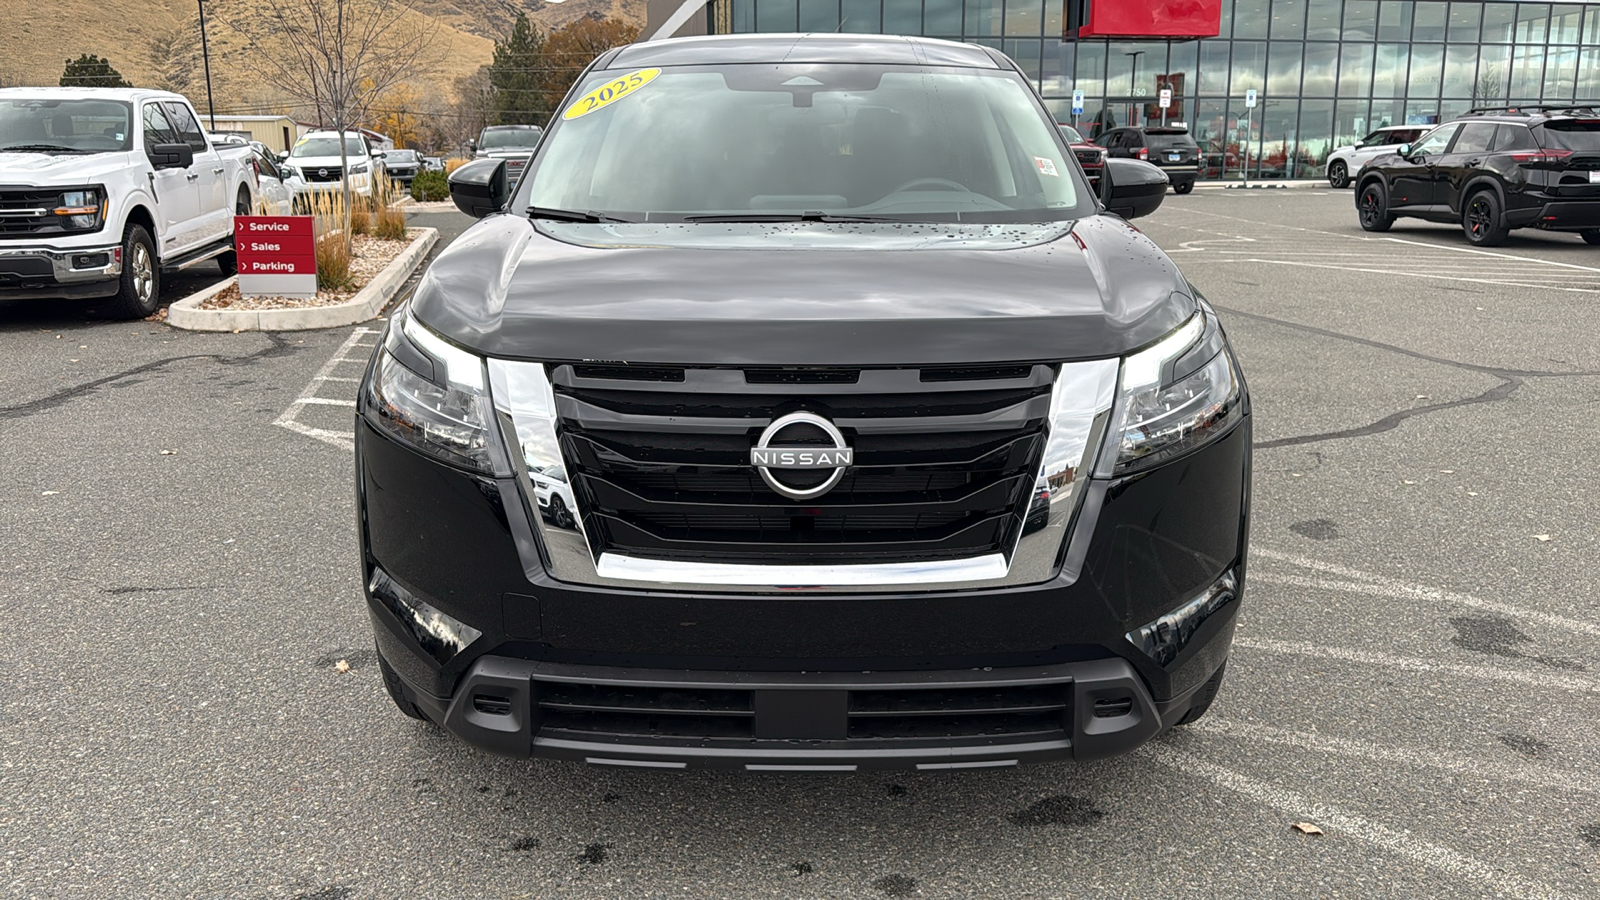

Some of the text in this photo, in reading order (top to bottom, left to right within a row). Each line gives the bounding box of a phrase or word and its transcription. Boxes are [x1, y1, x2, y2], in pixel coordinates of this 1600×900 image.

[583, 72, 643, 112] 2025
[1126, 88, 1147, 97] 2750
[249, 222, 290, 231] Service
[251, 242, 281, 251] Sales
[252, 261, 295, 272] Parking
[753, 451, 850, 465] NISSAN
